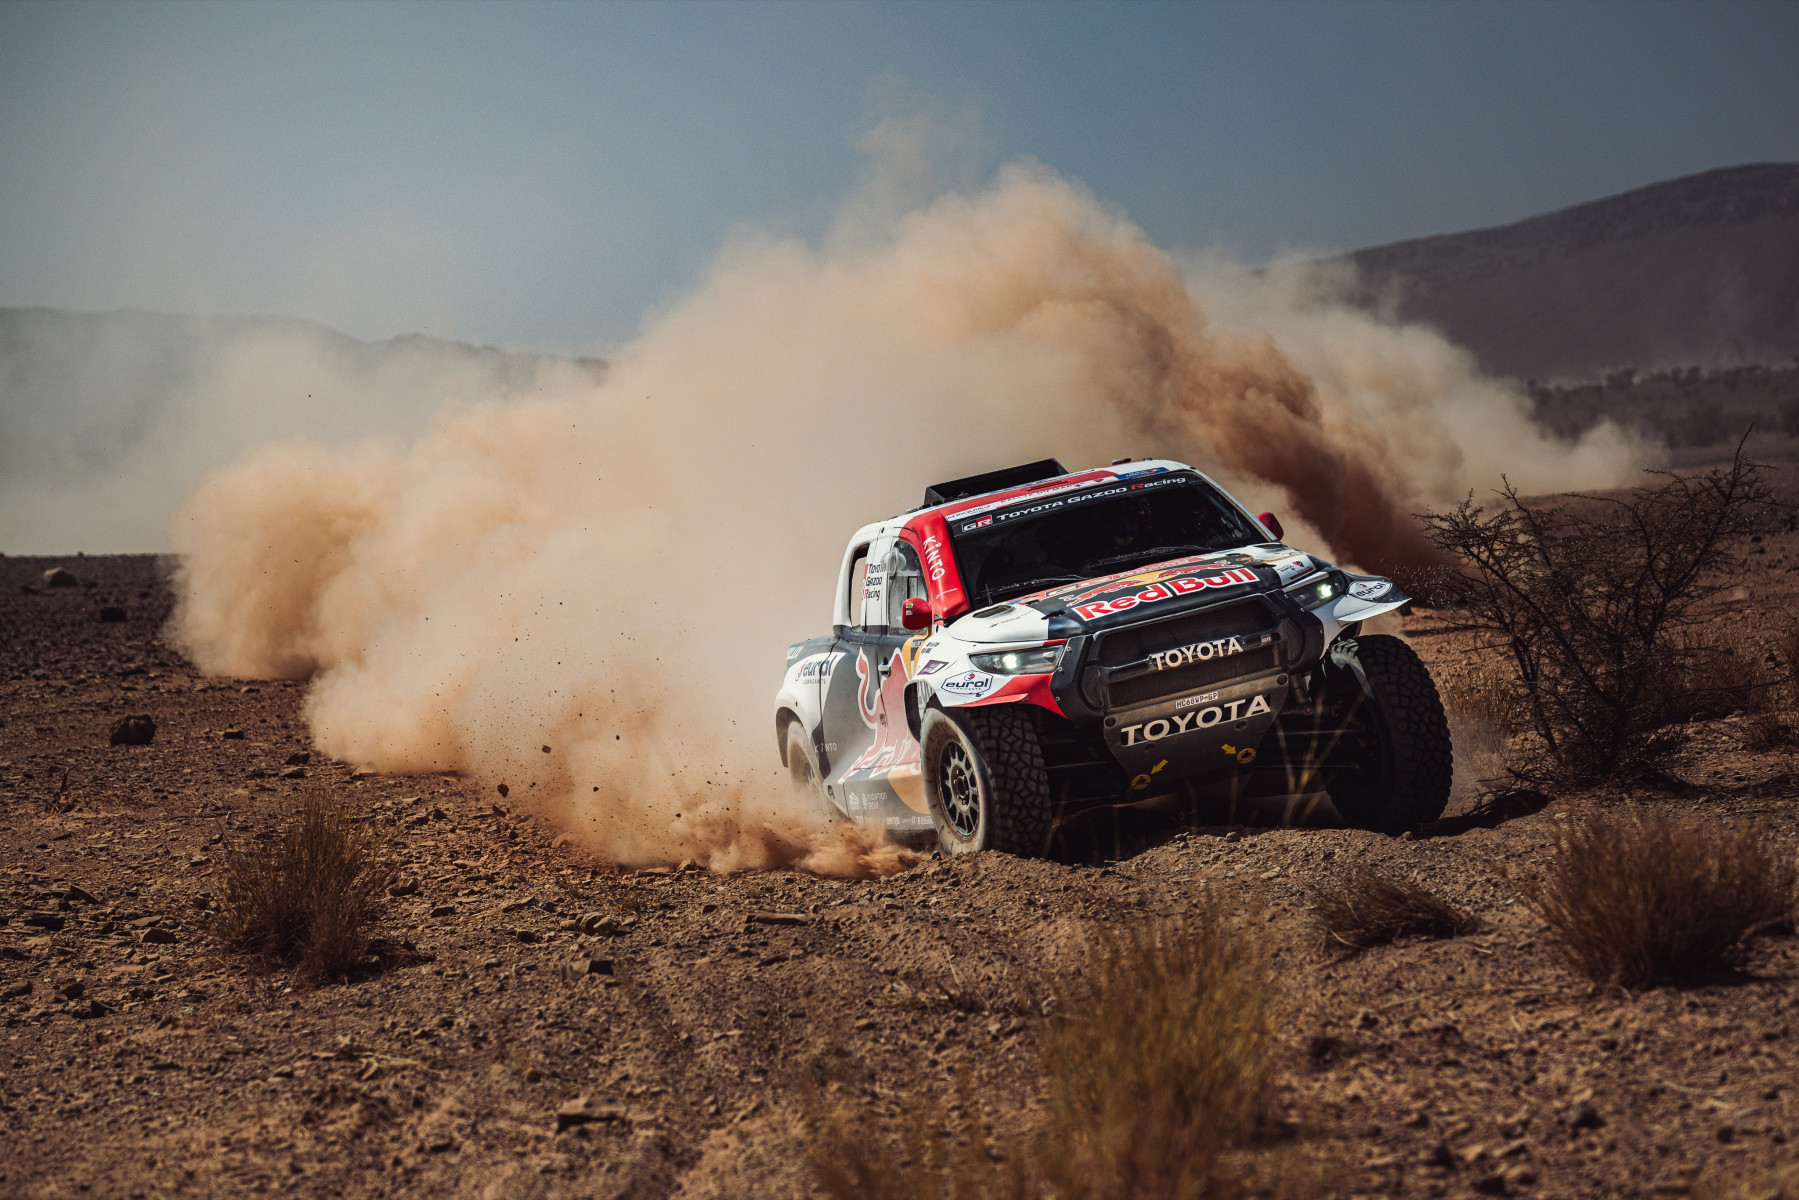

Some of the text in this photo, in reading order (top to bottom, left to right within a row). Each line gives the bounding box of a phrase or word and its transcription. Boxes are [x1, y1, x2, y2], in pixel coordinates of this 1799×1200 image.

[963, 477, 1186, 531] GR TOYOTA GAZOO Racing
[864, 588, 880, 601] Racing
[1071, 583, 1173, 622] Red
[1164, 567, 1260, 596] Bull
[1356, 582, 1386, 597] eurol
[802, 654, 838, 677] eurol
[1151, 636, 1243, 671] TOYOTA
[945, 678, 989, 688] eurol
[1121, 695, 1271, 746] TOYOTA
